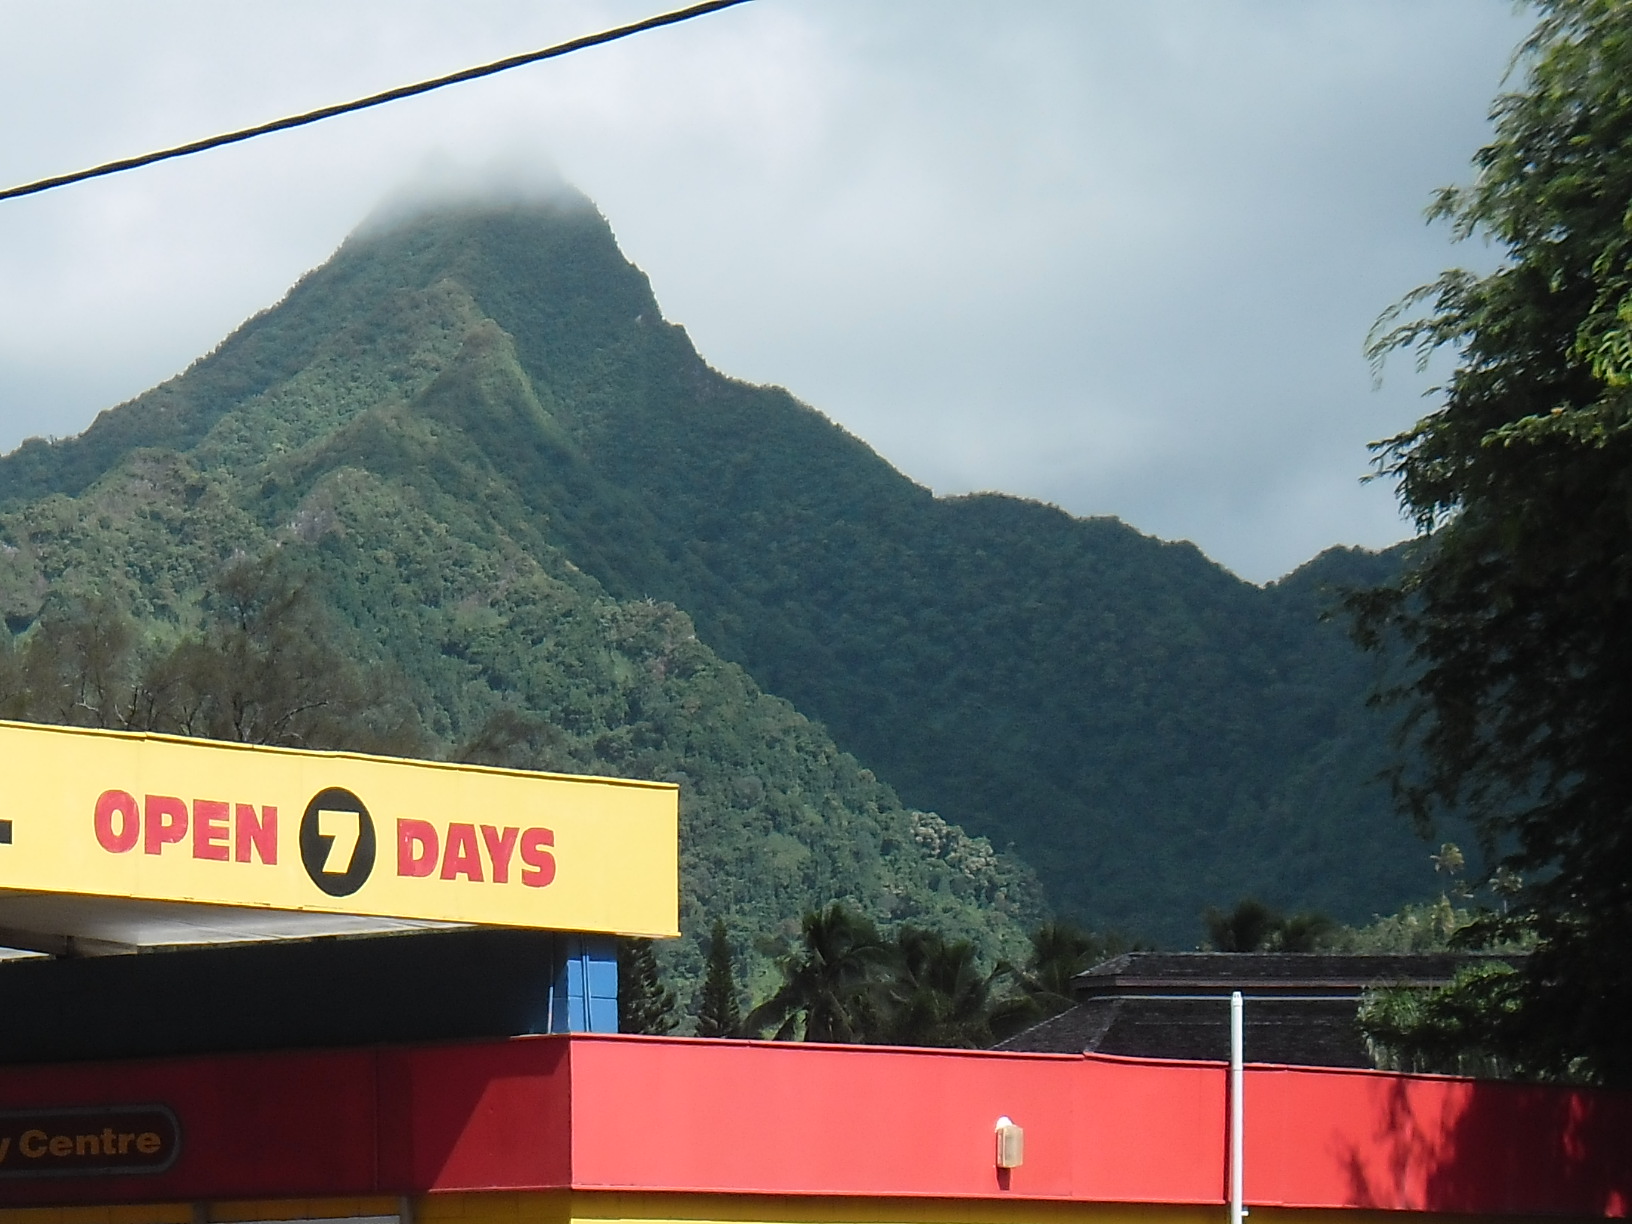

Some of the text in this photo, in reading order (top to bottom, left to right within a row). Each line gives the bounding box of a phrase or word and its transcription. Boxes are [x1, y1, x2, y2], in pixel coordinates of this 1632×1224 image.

[94, 788, 278, 867] OPEN
[397, 817, 557, 888] DAYS
[19, 1127, 161, 1159] Centre
